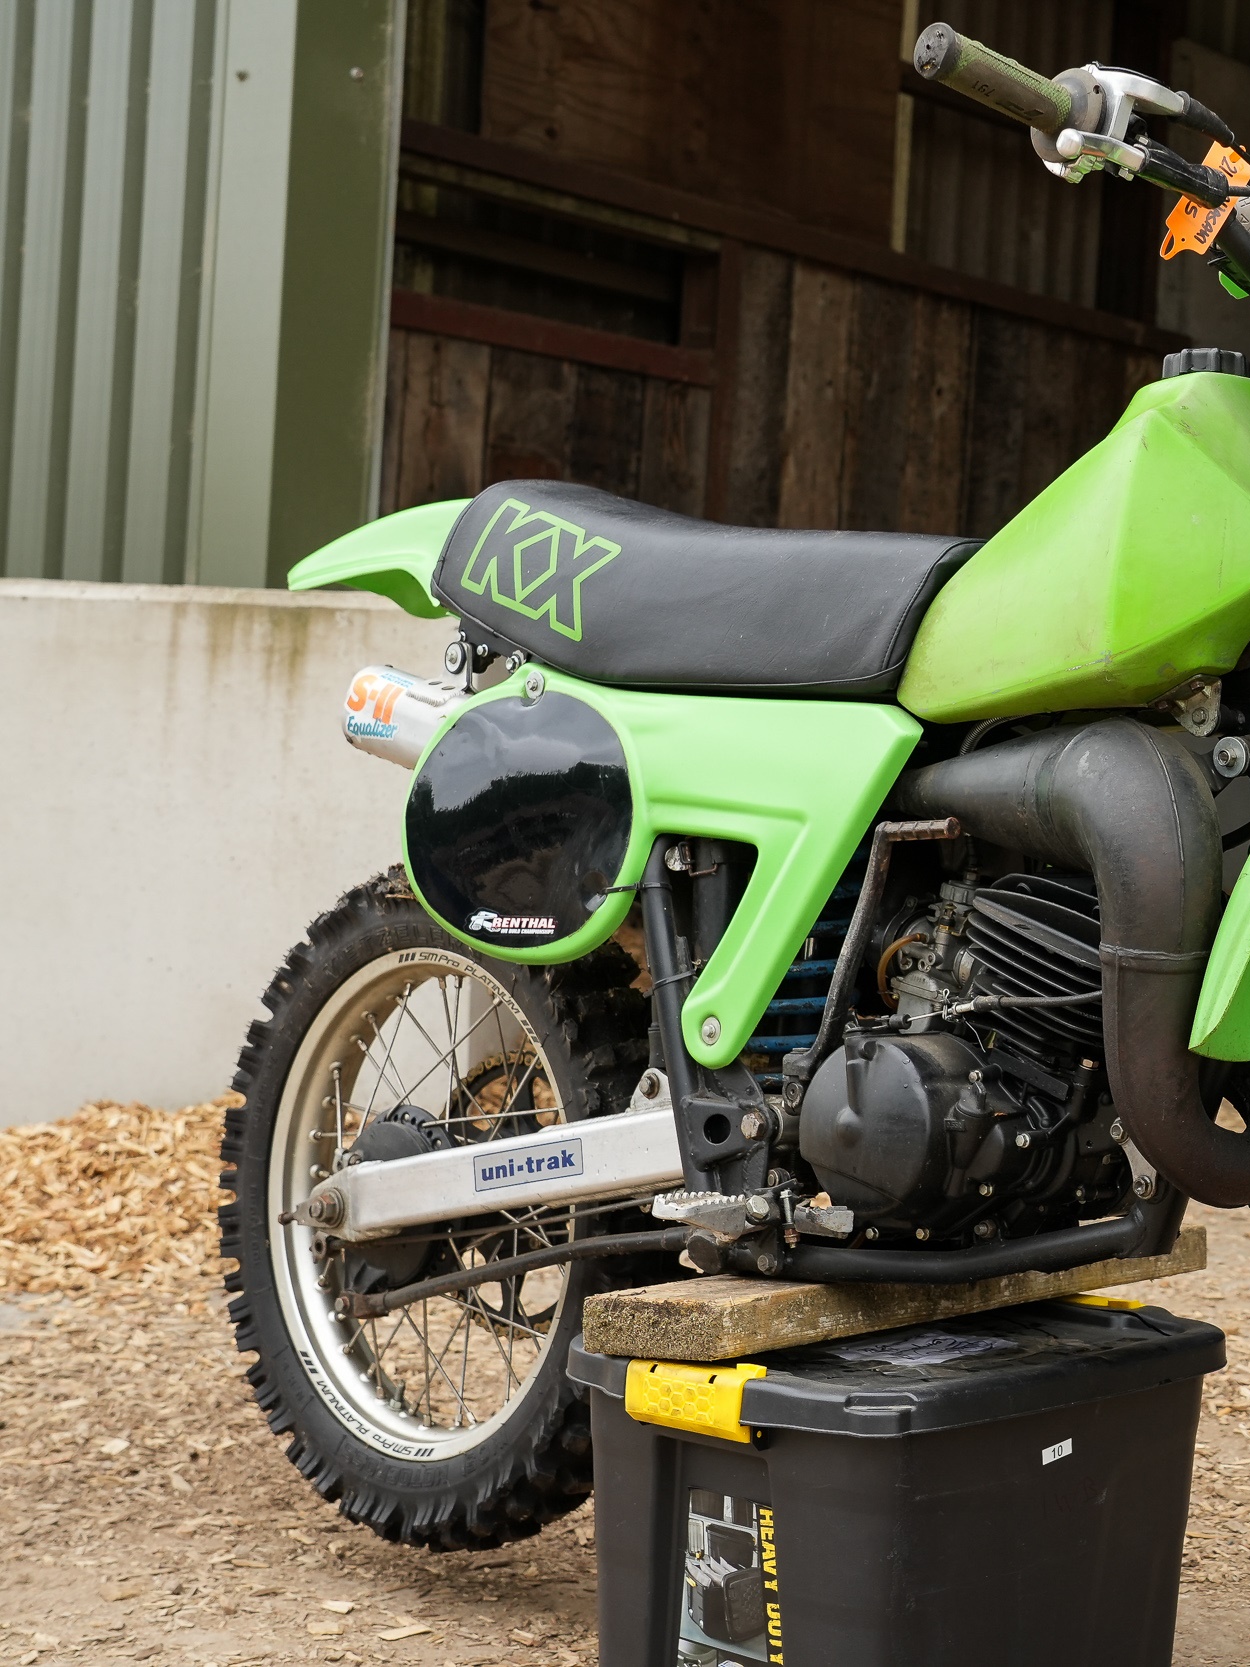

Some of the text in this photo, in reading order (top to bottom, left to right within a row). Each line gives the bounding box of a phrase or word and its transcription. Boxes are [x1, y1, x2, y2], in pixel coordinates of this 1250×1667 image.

[461, 497, 622, 642] KX
[346, 715, 398, 739] Equalizer
[491, 917, 556, 929] RENTHAL
[463, 965, 520, 1016] PLATINUM
[481, 1149, 576, 1182] uni-trak
[316, 1380, 371, 1435] PLATINUM
[1051, 1444, 1064, 1459] 10
[758, 1506, 779, 1593] HEAVY
